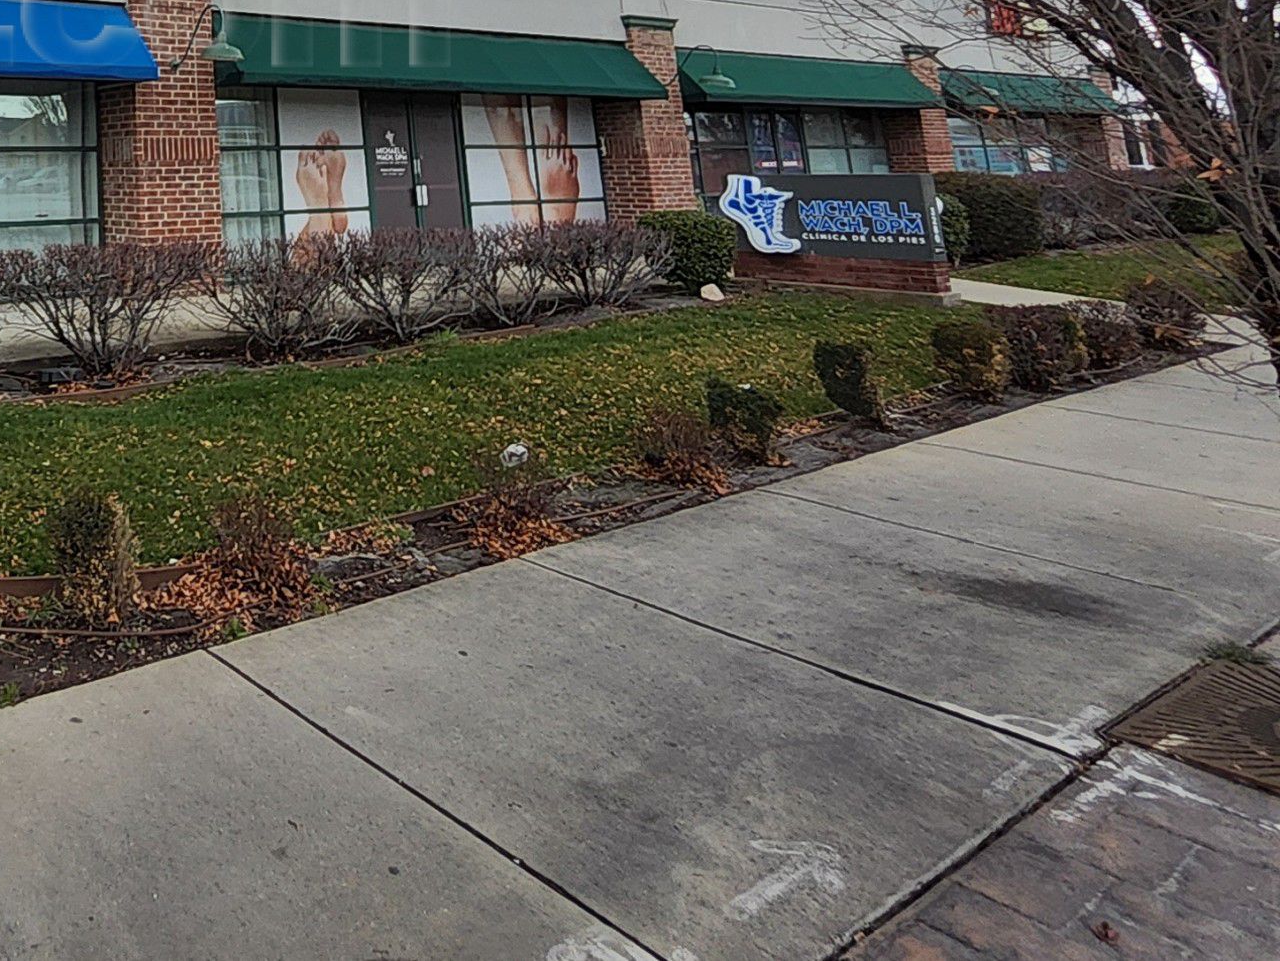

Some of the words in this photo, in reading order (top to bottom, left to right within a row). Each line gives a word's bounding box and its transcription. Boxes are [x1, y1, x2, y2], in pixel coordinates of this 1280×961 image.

[798, 199, 898, 218] MICHAEL
[899, 201, 922, 219] L.
[800, 216, 870, 235] WACH,
[871, 217, 925, 236] DPM
[851, 233, 867, 243] DE
[871, 234, 895, 244] LOS
[898, 236, 927, 245] PIES
